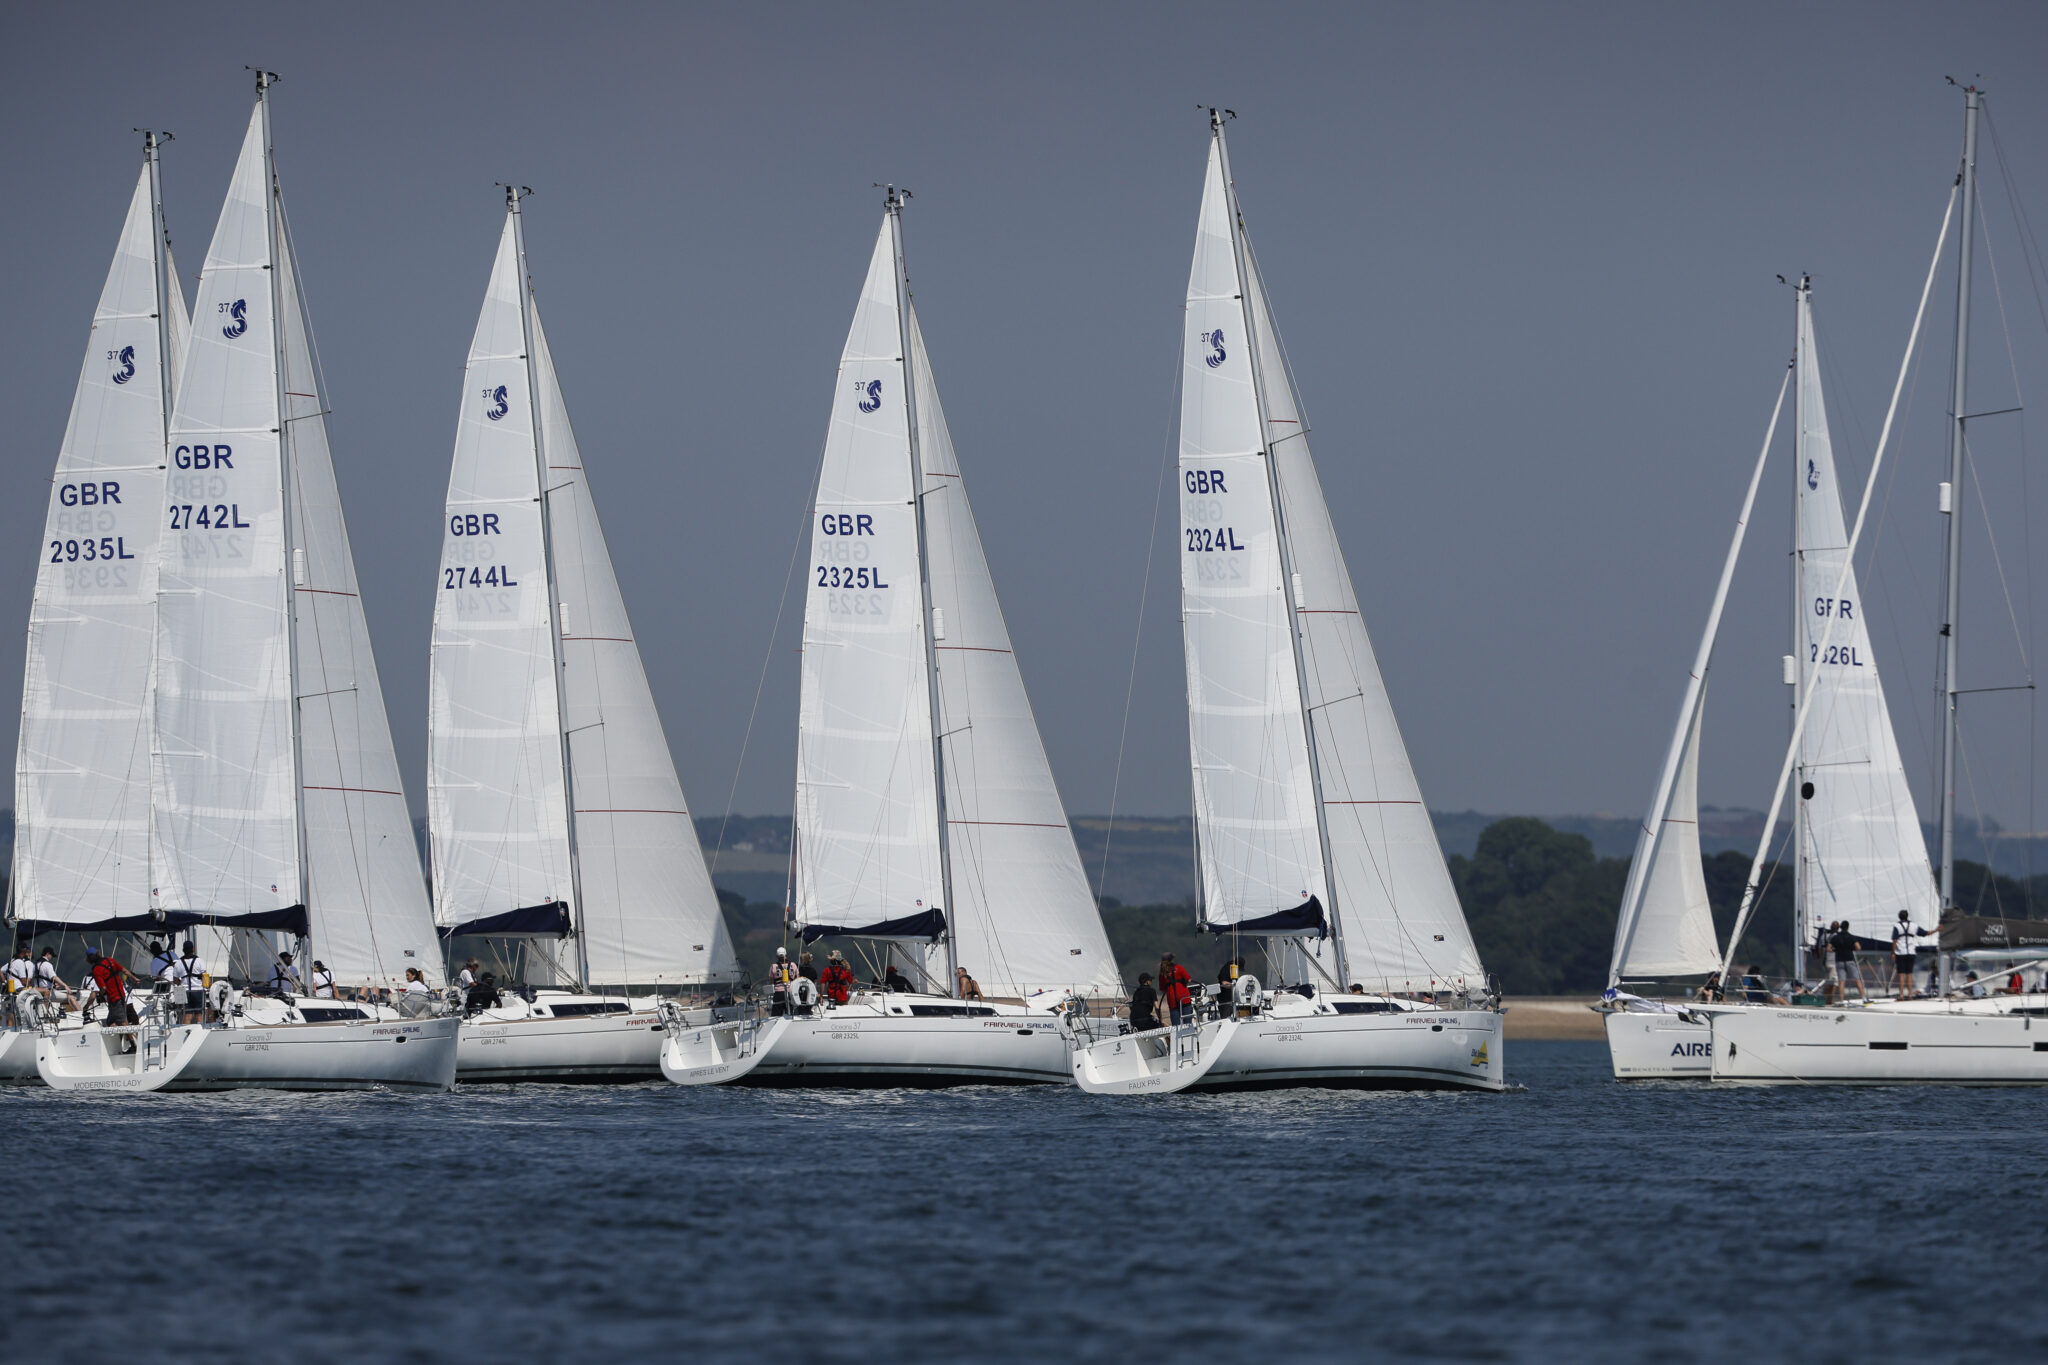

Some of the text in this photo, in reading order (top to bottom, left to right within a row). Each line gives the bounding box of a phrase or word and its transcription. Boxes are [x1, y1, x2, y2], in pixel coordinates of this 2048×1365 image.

[218, 303, 230, 313] 37
[1201, 332, 1210, 343] 37
[107, 351, 119, 360] 37
[854, 381, 866, 391] 37
[482, 389, 493, 399] 37
[175, 445, 234, 470] GBR
[1186, 470, 1228, 494] GBR
[60, 481, 122, 507] GBR
[169, 504, 250, 530] 2742L
[450, 513, 501, 536] GBR
[822, 514, 875, 536] GBR
[1186, 527, 1245, 552] 2324L
[50, 537, 135, 563] 2935L
[444, 565, 518, 590] 2744L
[817, 566, 889, 589] 2325L
[983, 1021, 1024, 1029] FAIRVIEW
[372, 1028, 401, 1036] FAIRVIEW
[831, 1032, 843, 1040] GBR
[1277, 1034, 1288, 1042] GBR
[244, 1044, 255, 1052] GBR
[715, 1065, 730, 1075] VENT
[74, 1079, 142, 1090] MODERNISTIC LADY
[1128, 1079, 1161, 1090] FAUX PAS
